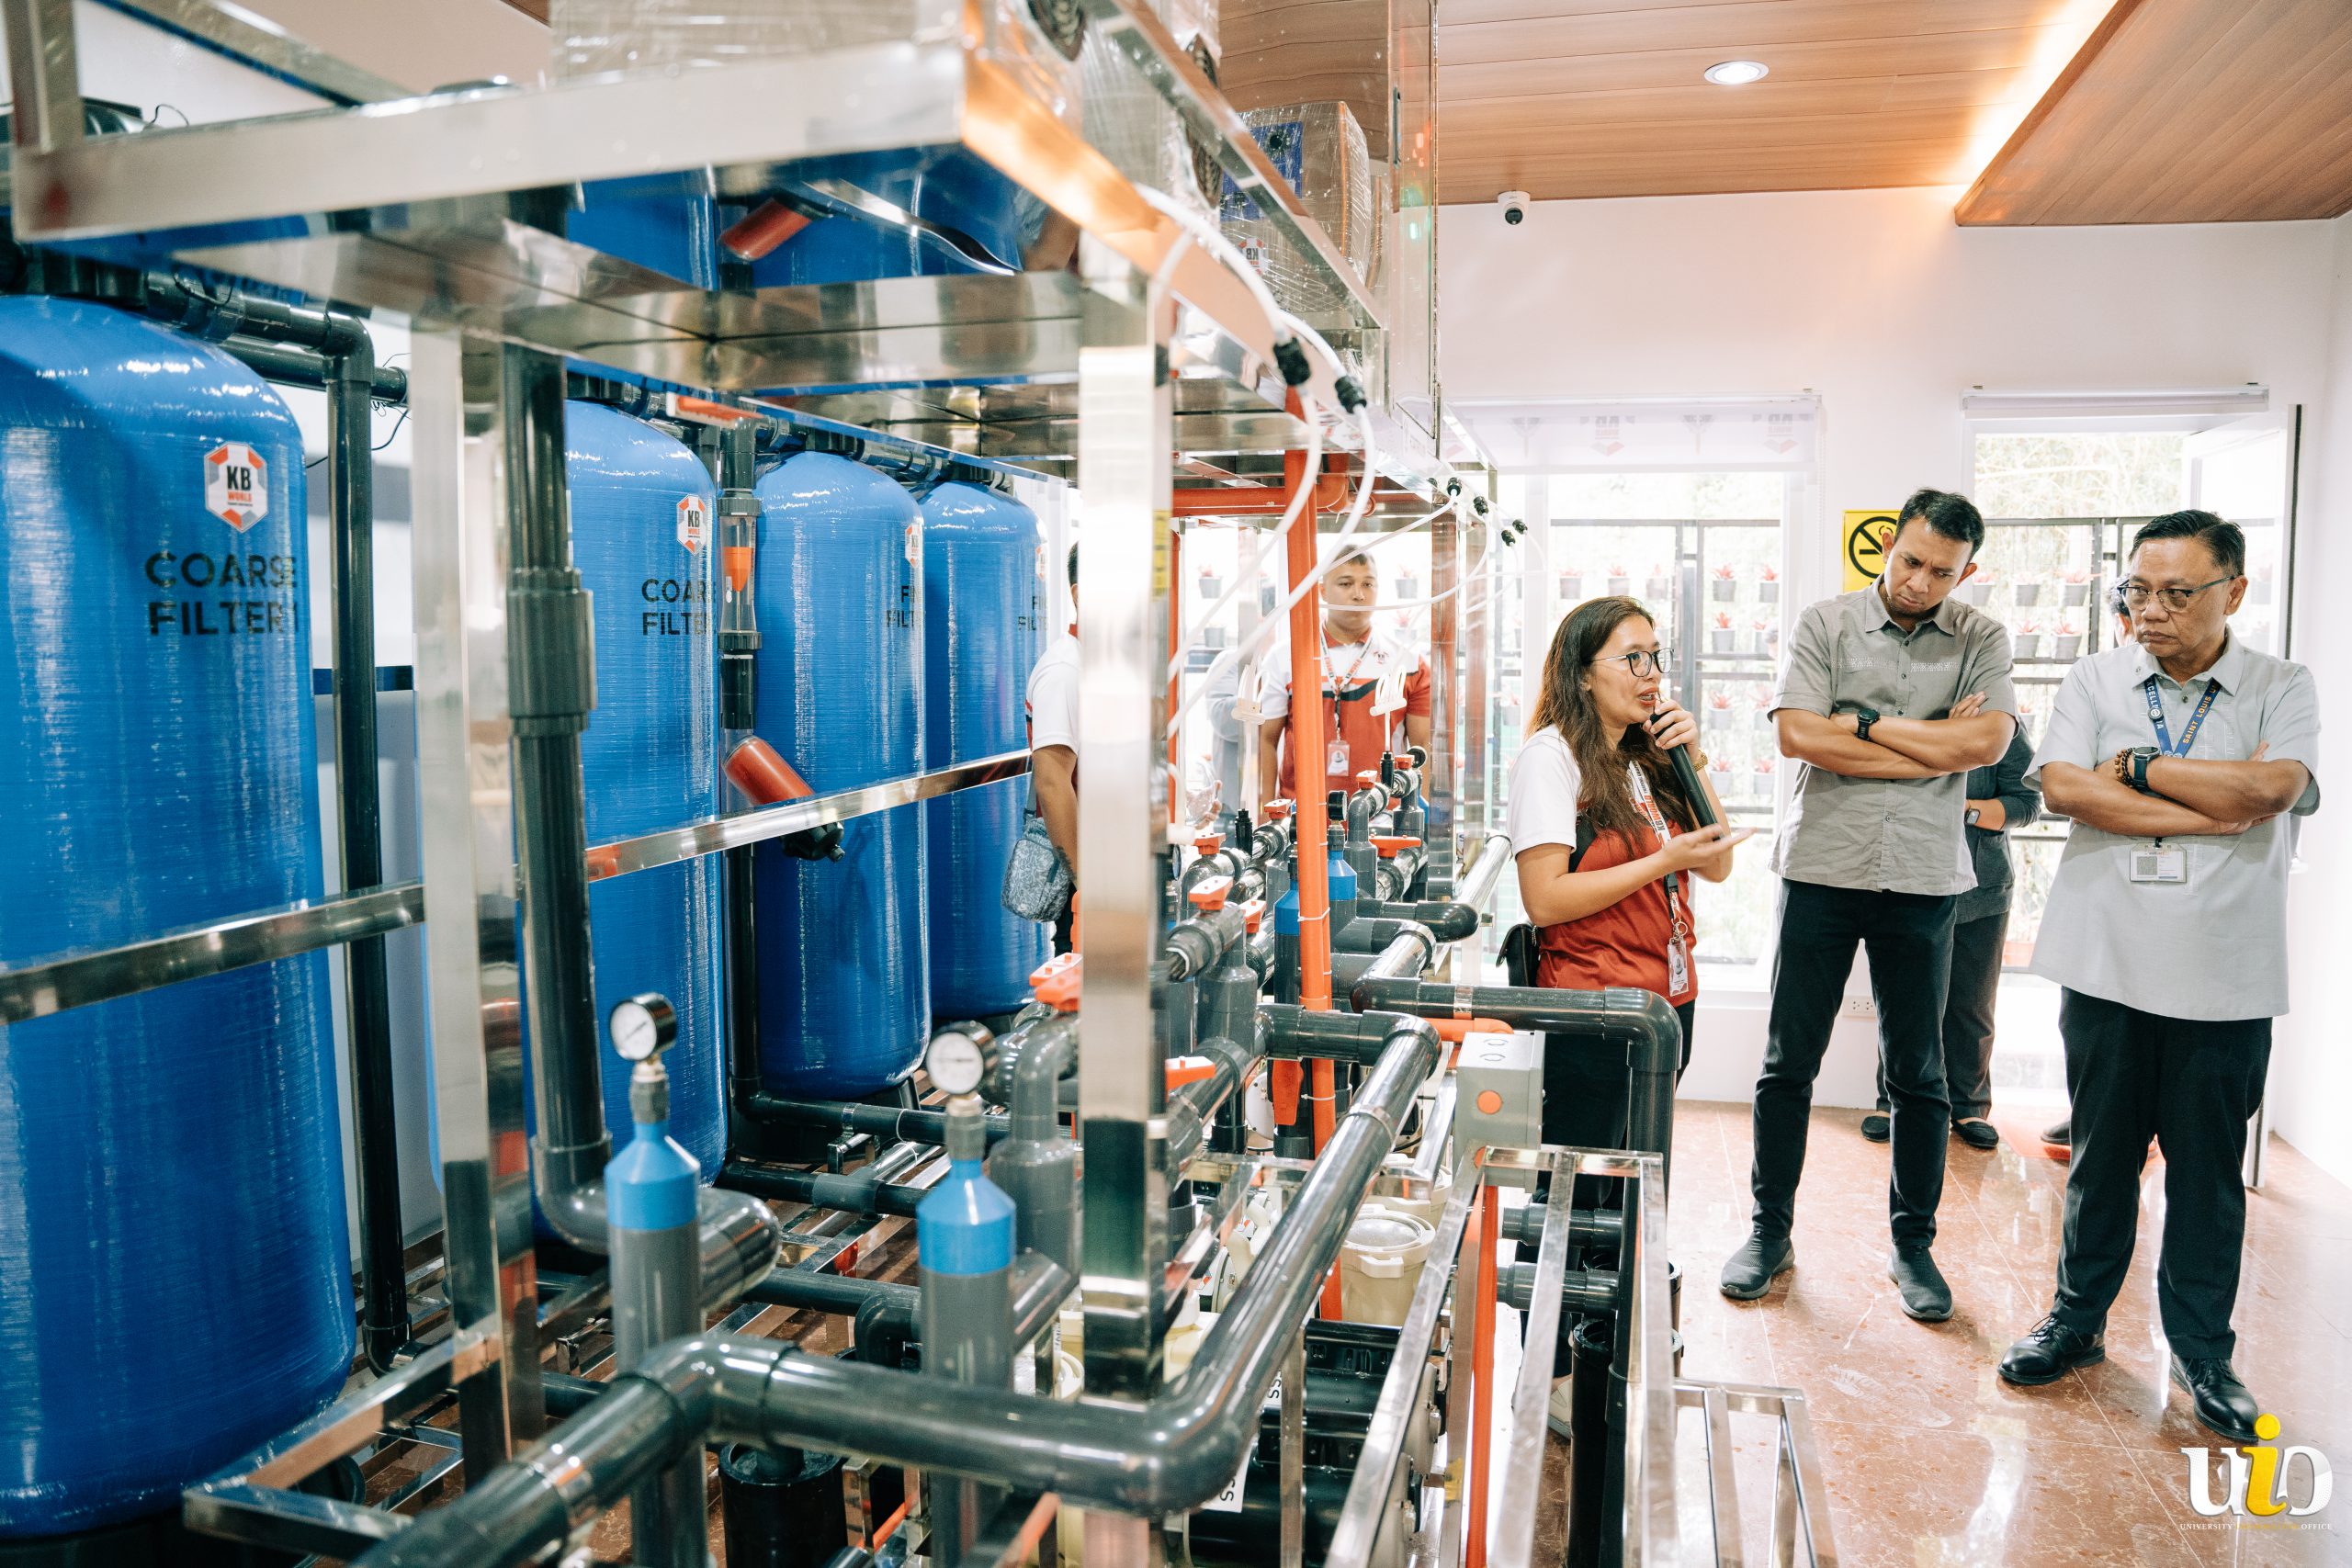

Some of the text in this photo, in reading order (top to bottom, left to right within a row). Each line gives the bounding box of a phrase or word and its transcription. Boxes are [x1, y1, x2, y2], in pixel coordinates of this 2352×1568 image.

[226, 466, 252, 491] KB
[687, 510, 700, 528] KB
[144, 552, 299, 589] COARSE
[641, 578, 707, 604] COAR
[148, 601, 284, 637] FILTER
[2182, 719, 2199, 744] SAINT
[2196, 695, 2211, 717] LOUIS
